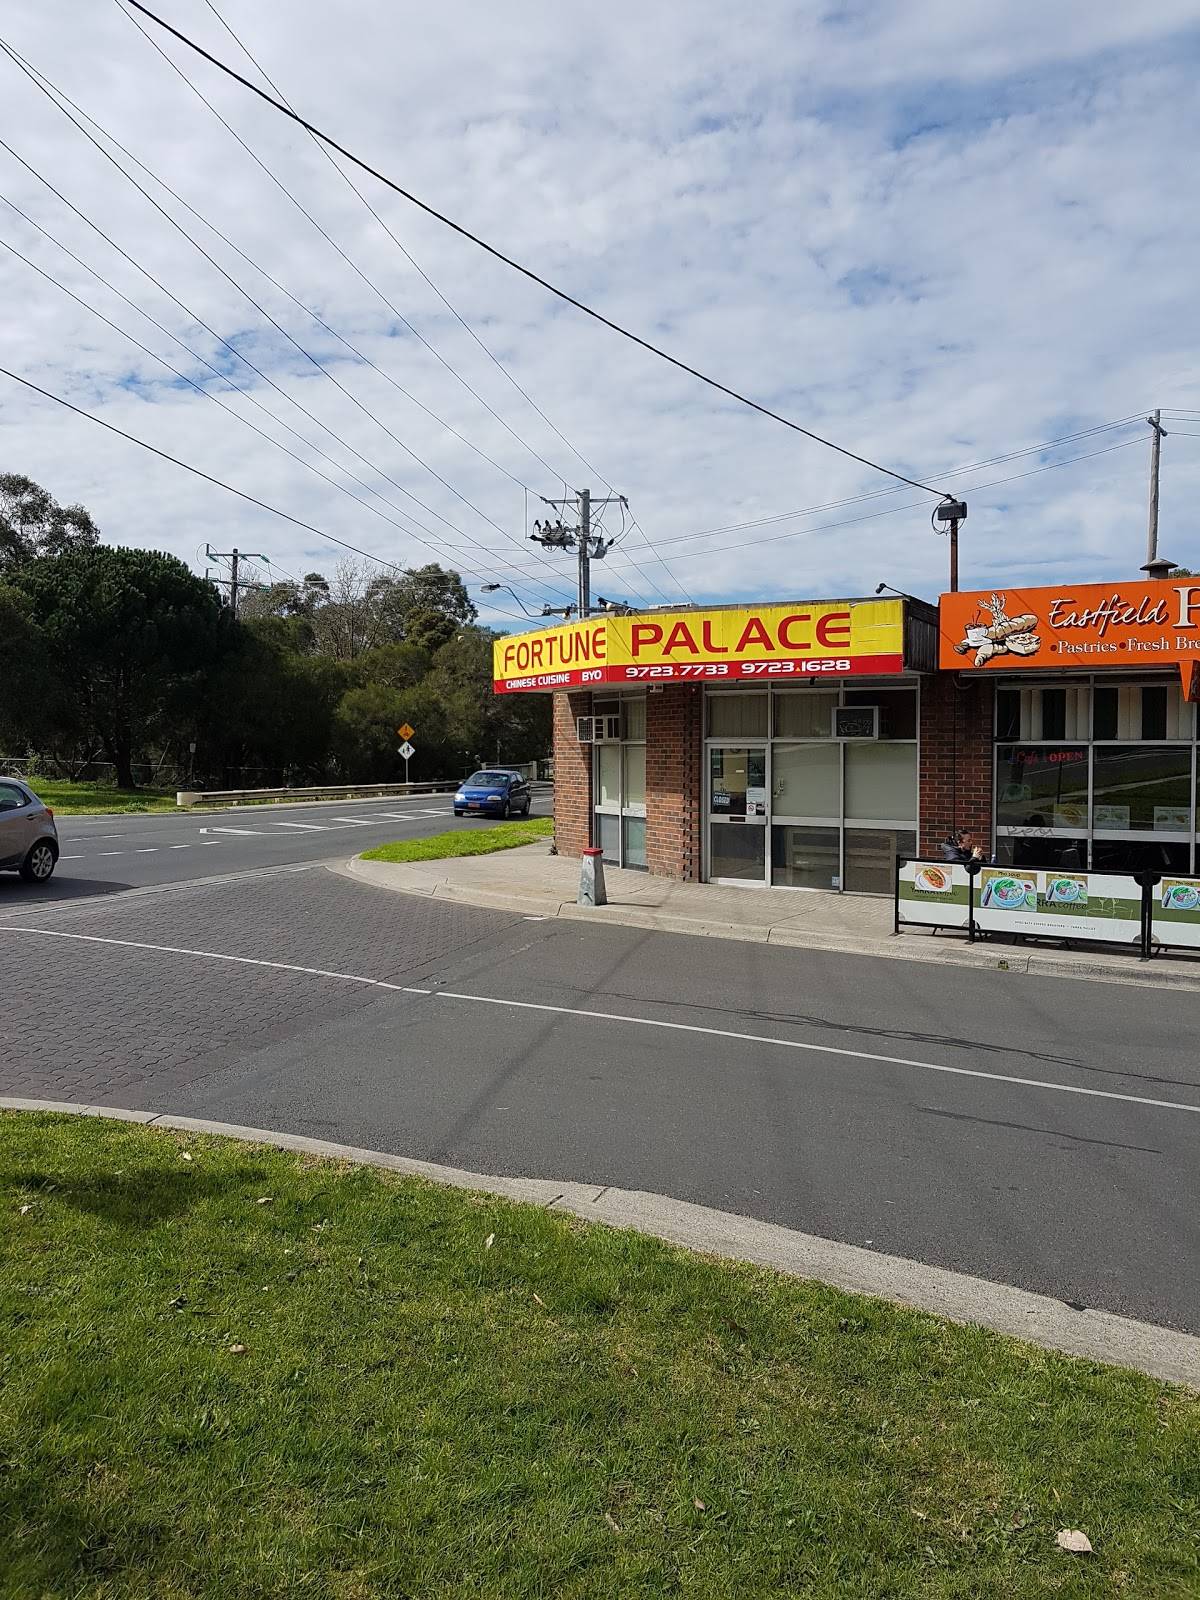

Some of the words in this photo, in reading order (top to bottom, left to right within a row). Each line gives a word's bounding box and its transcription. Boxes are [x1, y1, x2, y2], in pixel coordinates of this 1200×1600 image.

[1048, 593, 1168, 636] Eastfield
[504, 627, 606, 673] FORTUNE
[631, 612, 851, 657] PALACE
[1057, 639, 1117, 654] Pastries
[1126, 636, 1170, 651] Fresh
[506, 677, 536, 689] CHINESE
[538, 673, 570, 686] CUISINE
[581, 669, 602, 682] BYO
[1047, 751, 1084, 763] OPEN
